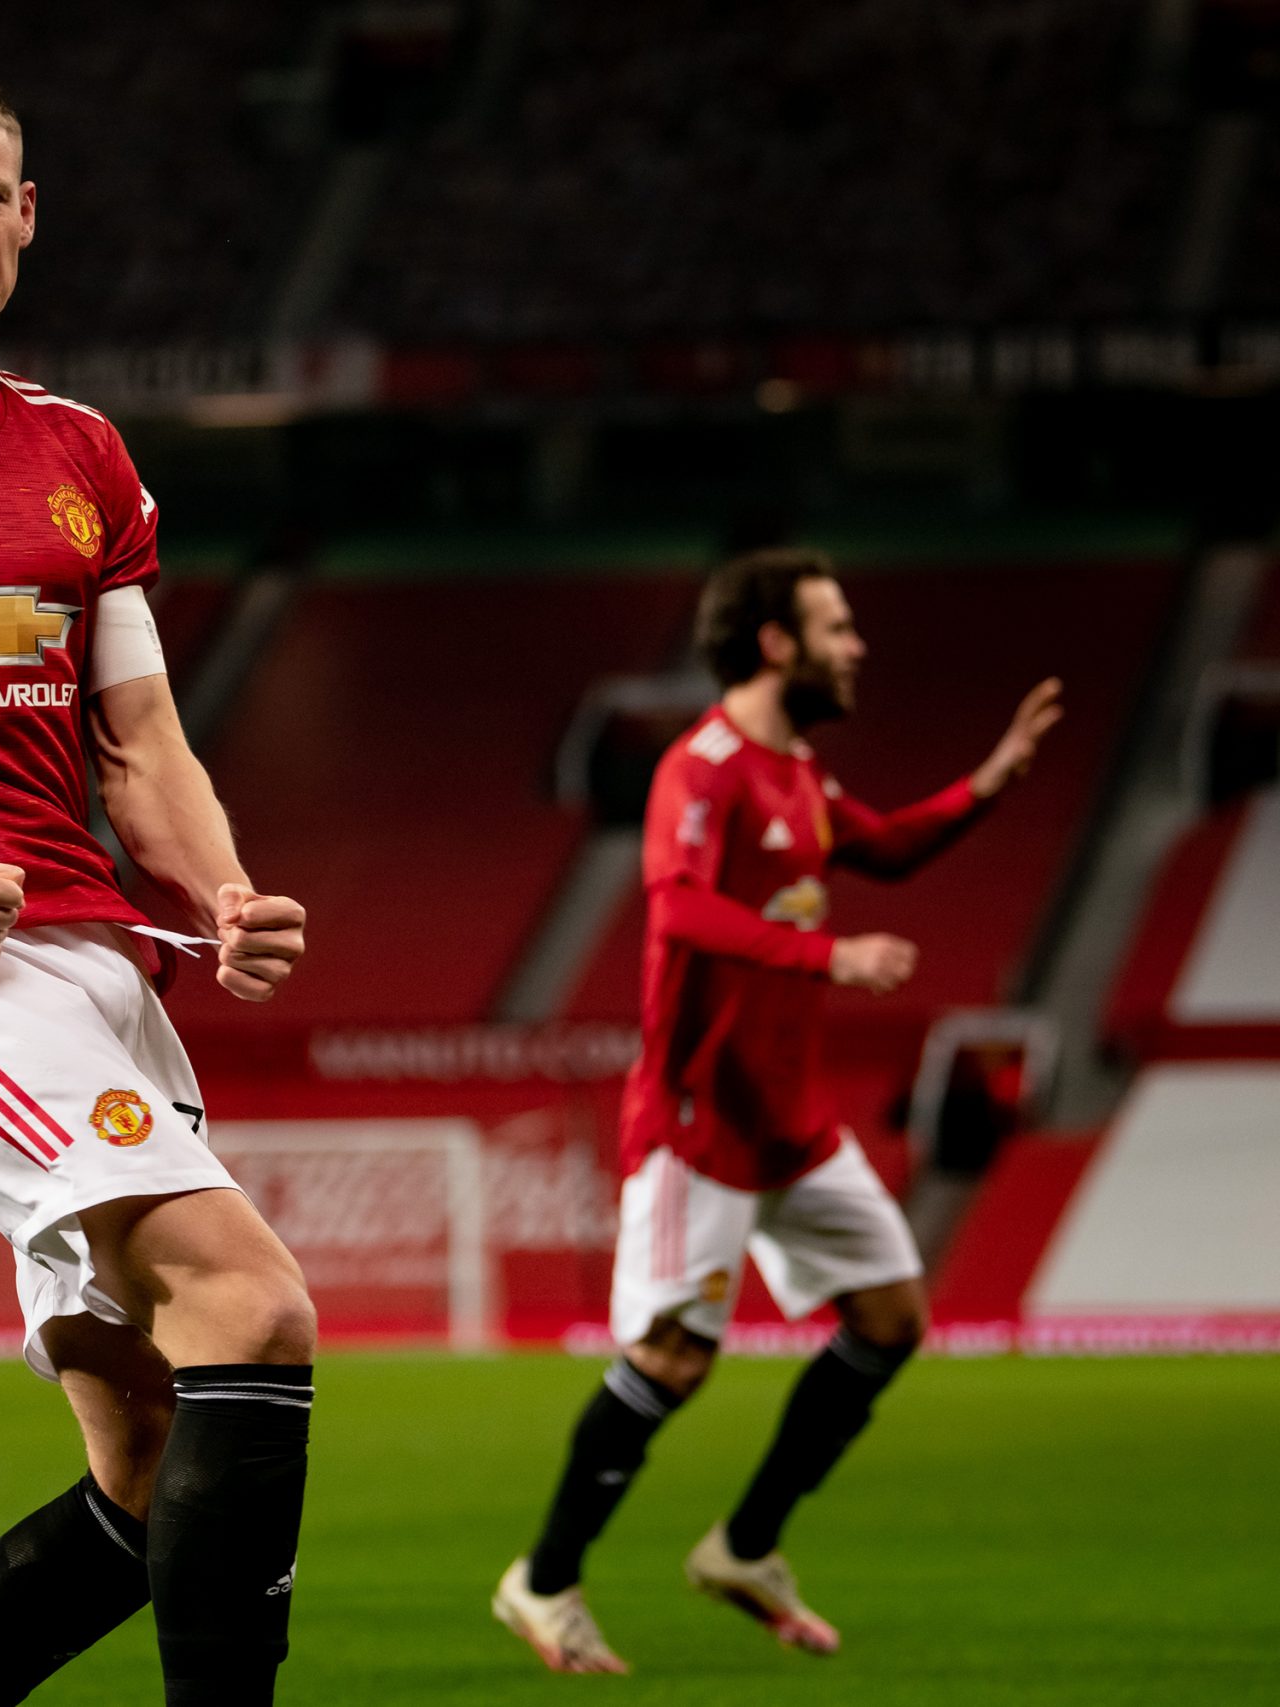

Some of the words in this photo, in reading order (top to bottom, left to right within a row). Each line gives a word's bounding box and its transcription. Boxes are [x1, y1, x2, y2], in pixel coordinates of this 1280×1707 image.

[51, 490, 94, 518] MANCHESTER
[70, 537, 95, 554] UNITED
[94, 1092, 138, 1125] MANCHESTER
[120, 1123, 152, 1145] UNITED
